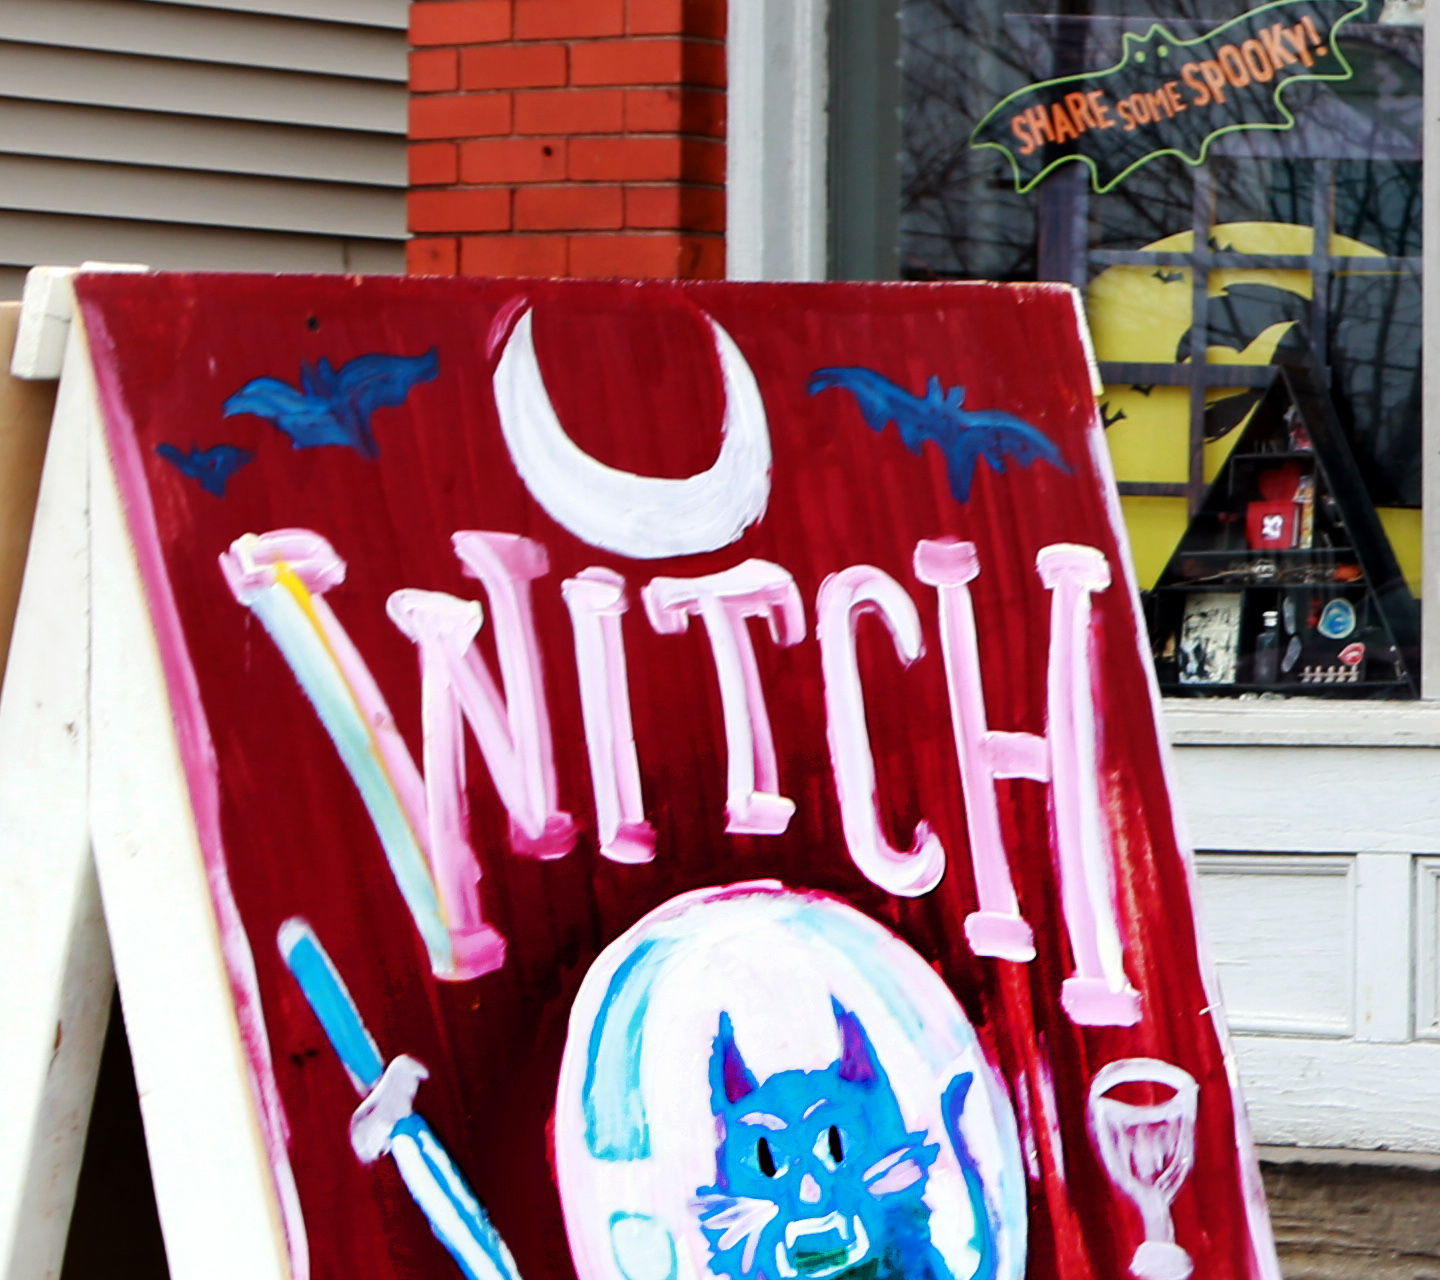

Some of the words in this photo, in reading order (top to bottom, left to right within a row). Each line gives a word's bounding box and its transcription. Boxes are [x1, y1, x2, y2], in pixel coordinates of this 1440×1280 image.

[1010, 89, 1116, 156] SHARE
[1116, 80, 1187, 131] SOME
[1180, 15, 1328, 107] SPOOKY!
[219, 528, 1143, 1027] WITCH
